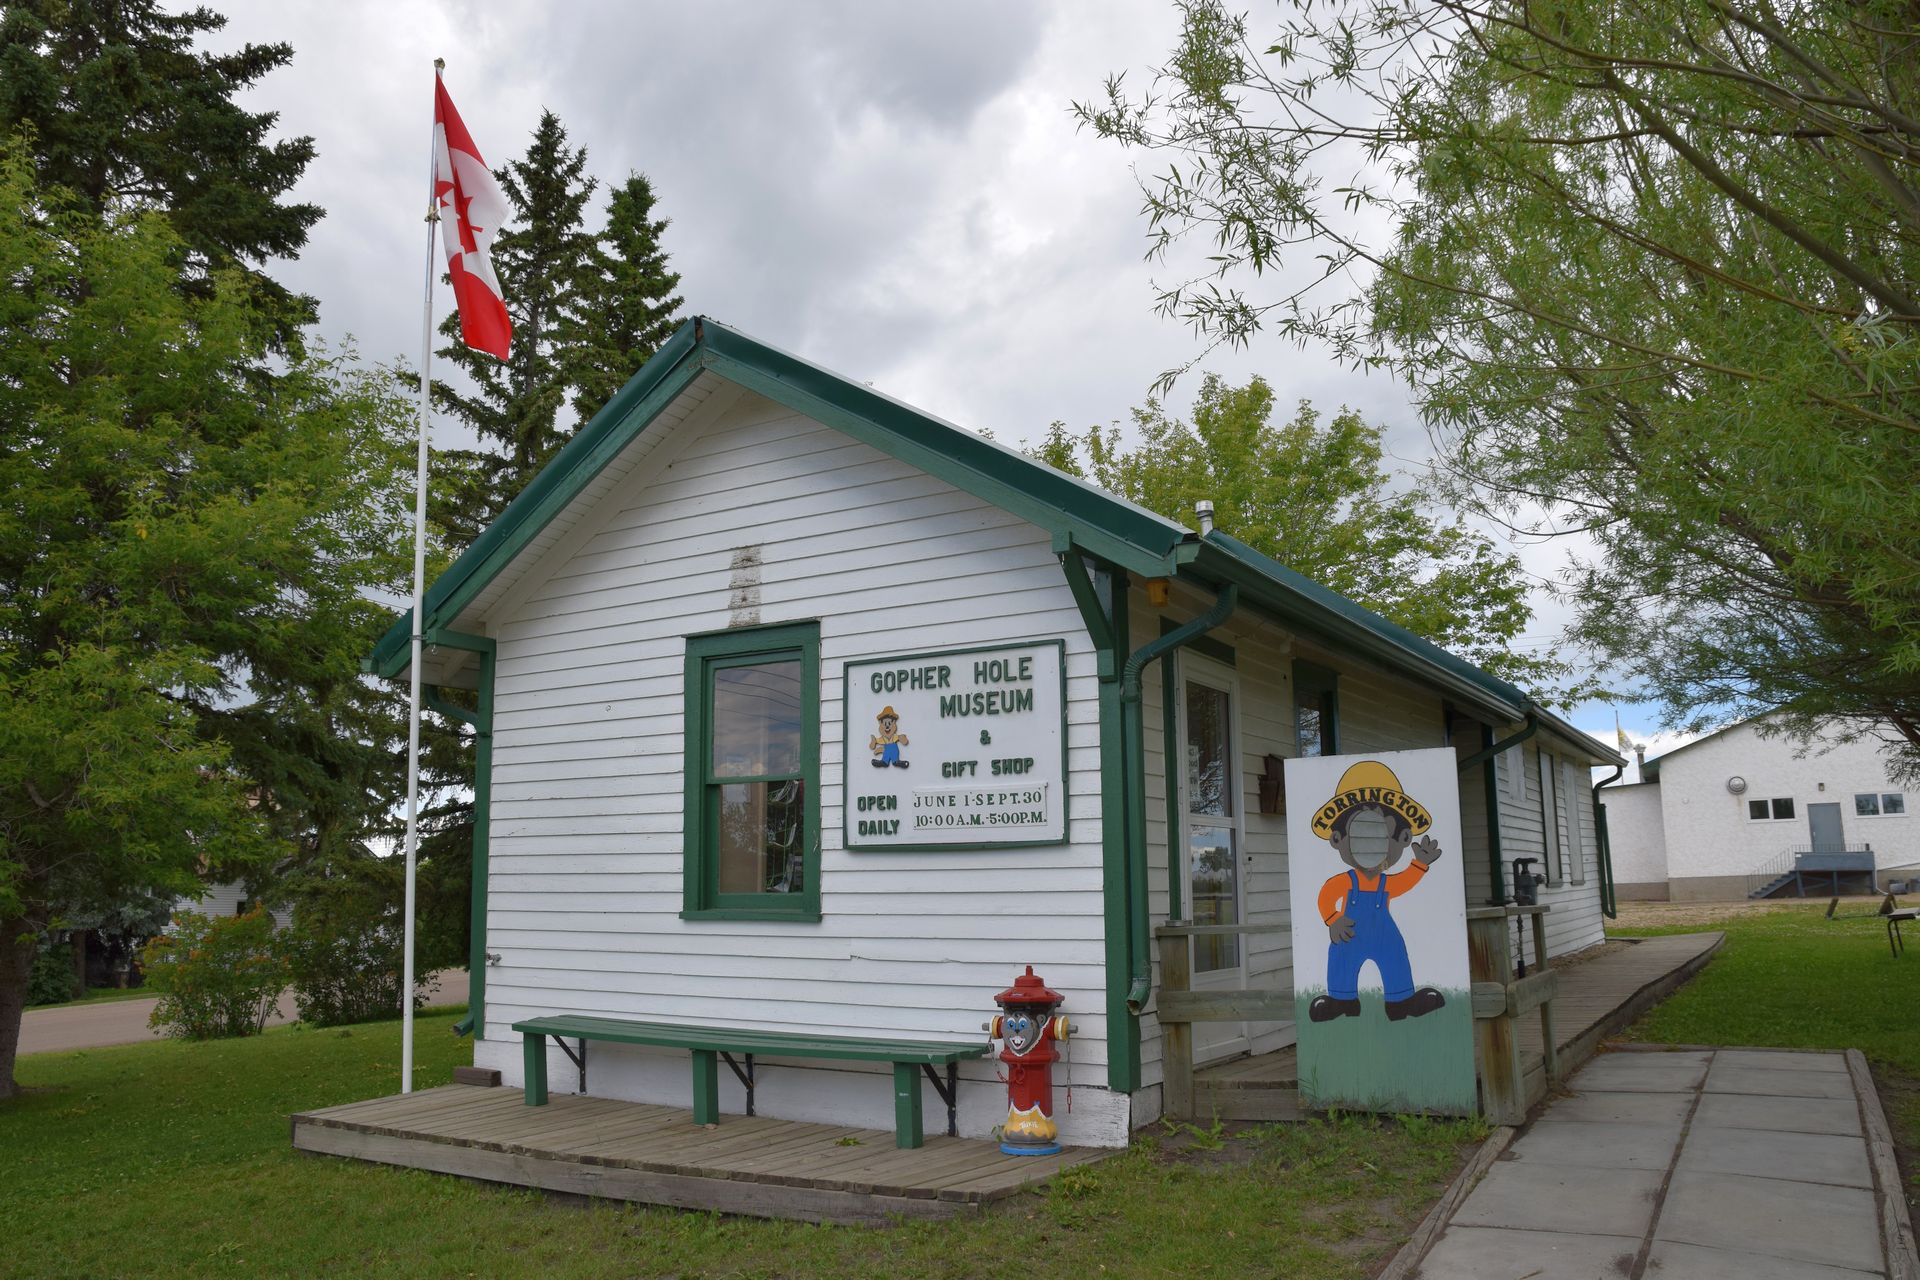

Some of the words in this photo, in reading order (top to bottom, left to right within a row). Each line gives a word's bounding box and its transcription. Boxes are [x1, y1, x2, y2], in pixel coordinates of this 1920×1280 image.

[870, 665, 951, 693] GOPHER
[974, 656, 1033, 685] HOLE
[940, 688, 1033, 718] MUSEUM
[980, 730, 991, 745] &
[941, 760, 978, 778] GIFT
[991, 758, 1034, 776] SHOP
[857, 795, 897, 812] OPEN
[913, 795, 956, 808] JUNE
[1314, 788, 1430, 830] TORRINGTON
[858, 819, 900, 836] DAILY
